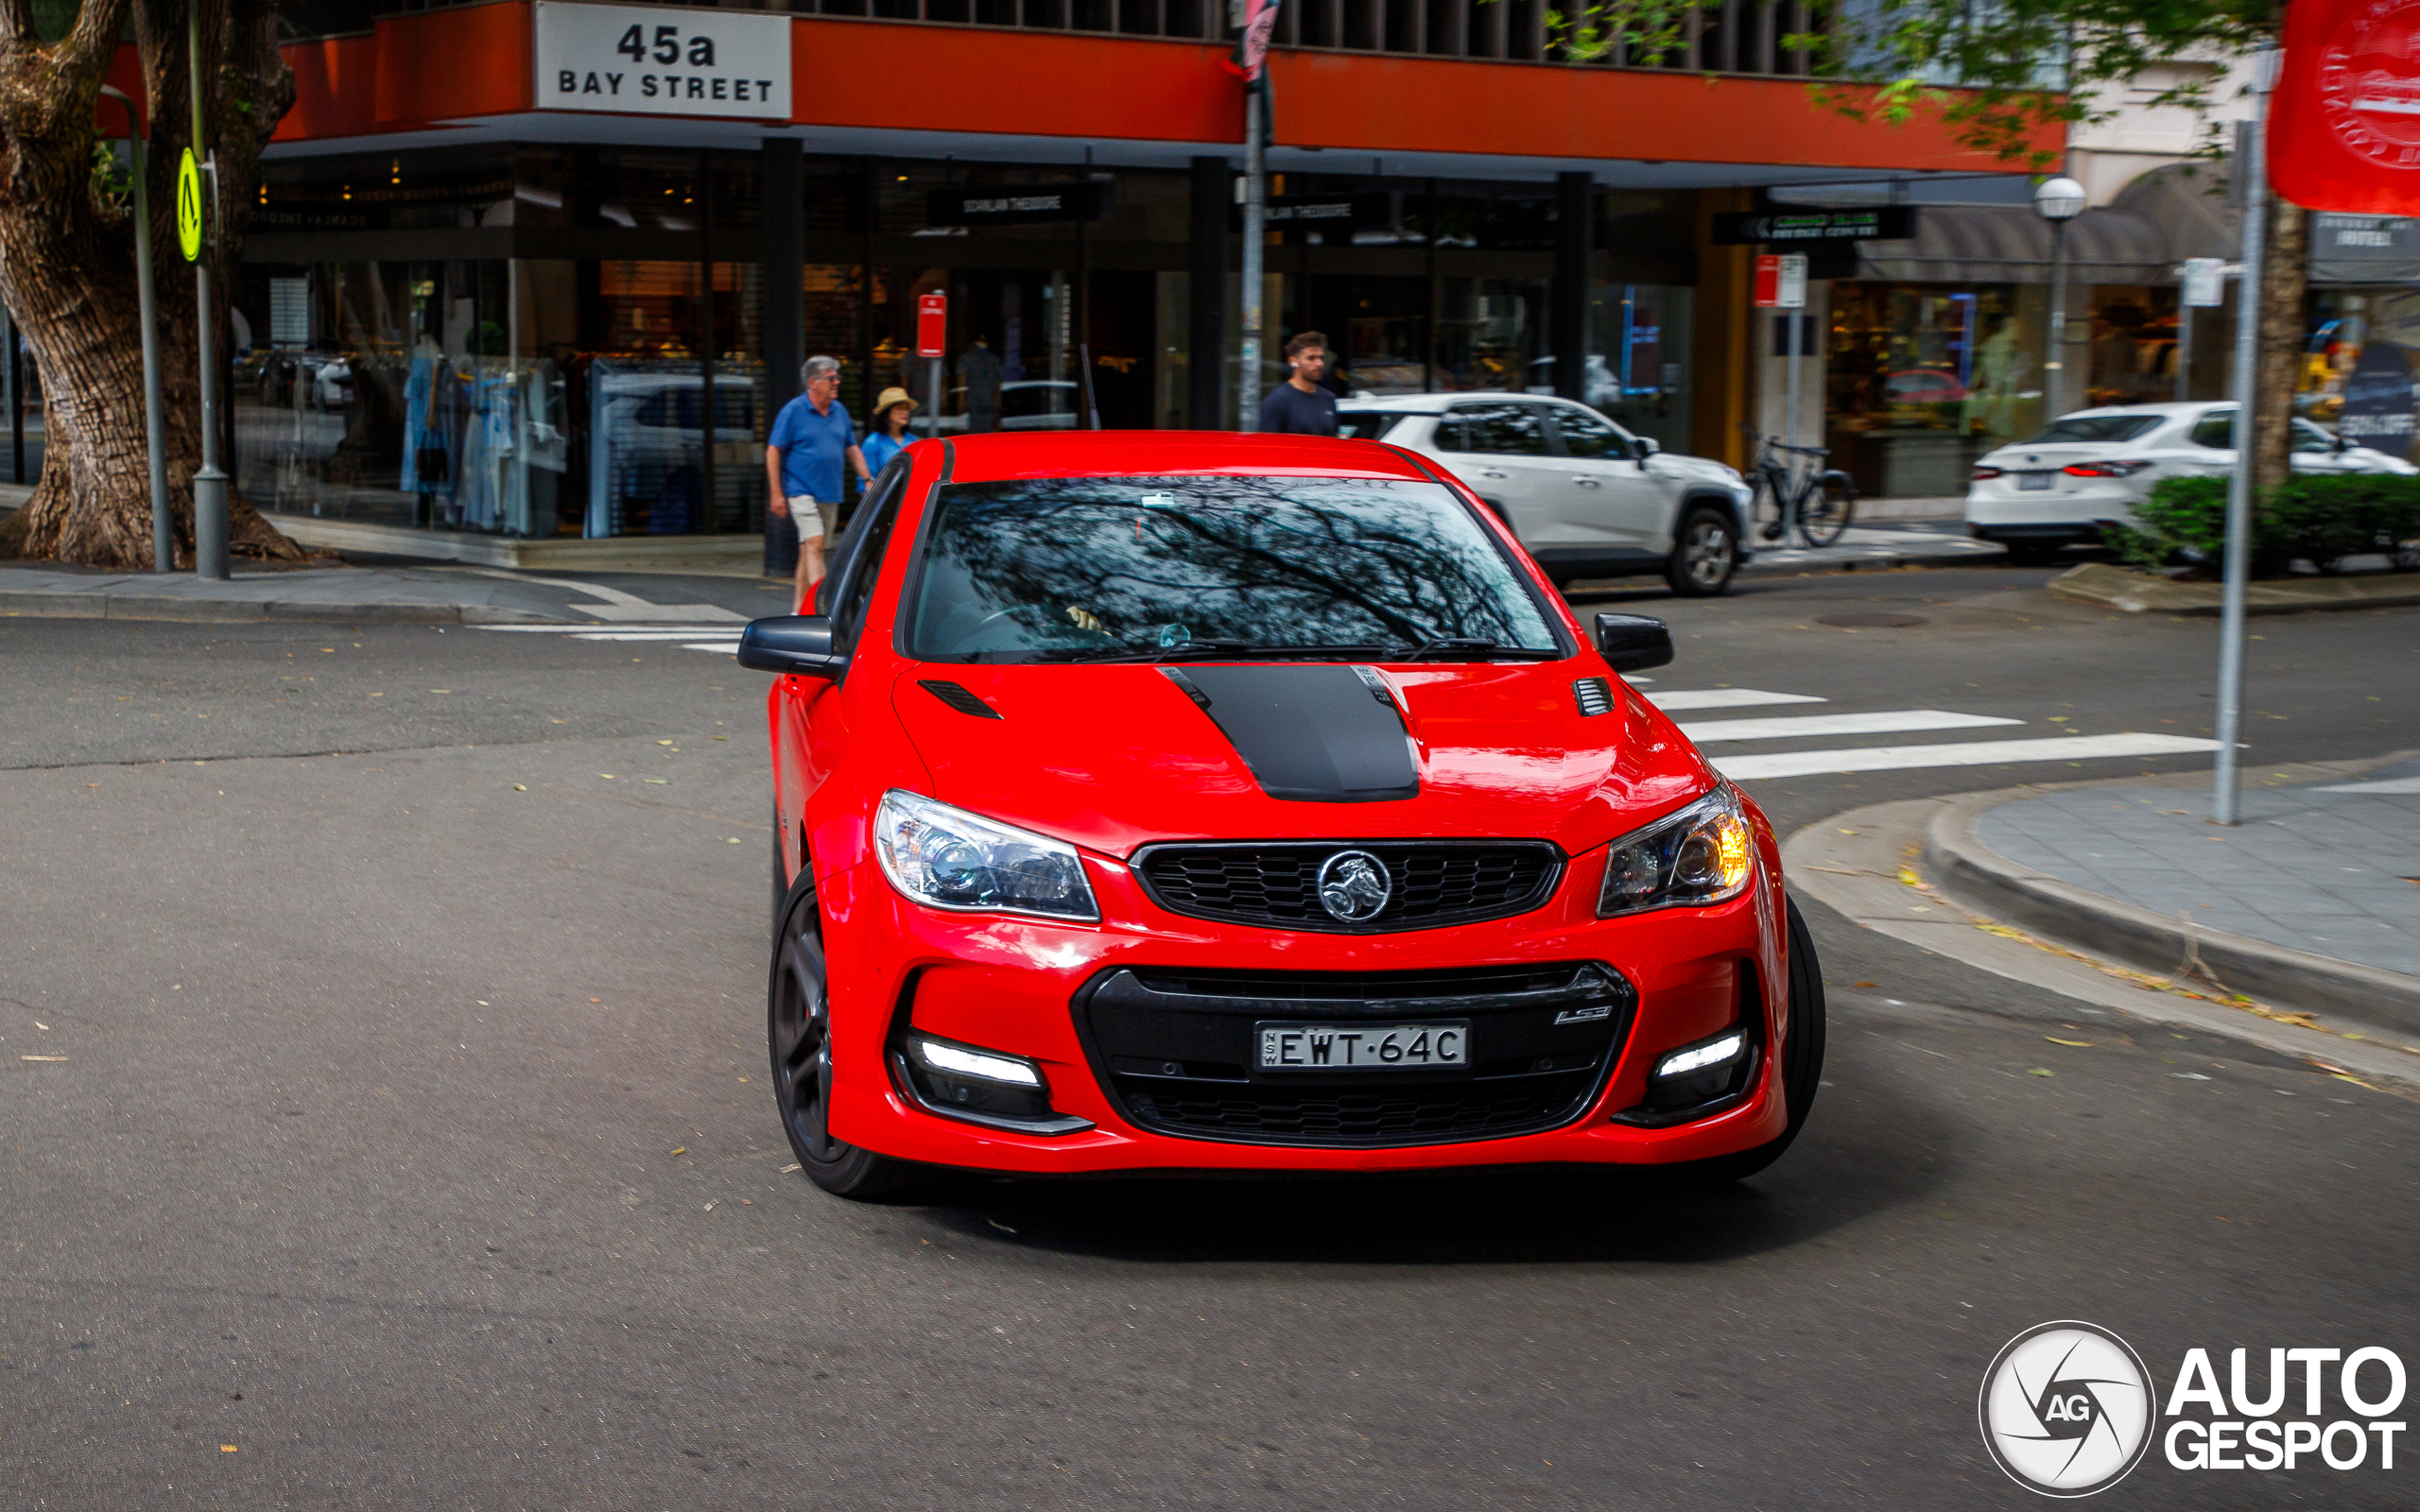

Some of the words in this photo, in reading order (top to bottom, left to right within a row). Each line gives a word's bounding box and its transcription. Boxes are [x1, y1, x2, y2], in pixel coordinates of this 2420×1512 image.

[617, 24, 716, 66] 45a
[559, 70, 624, 94] BAY
[641, 74, 772, 102] STREET
